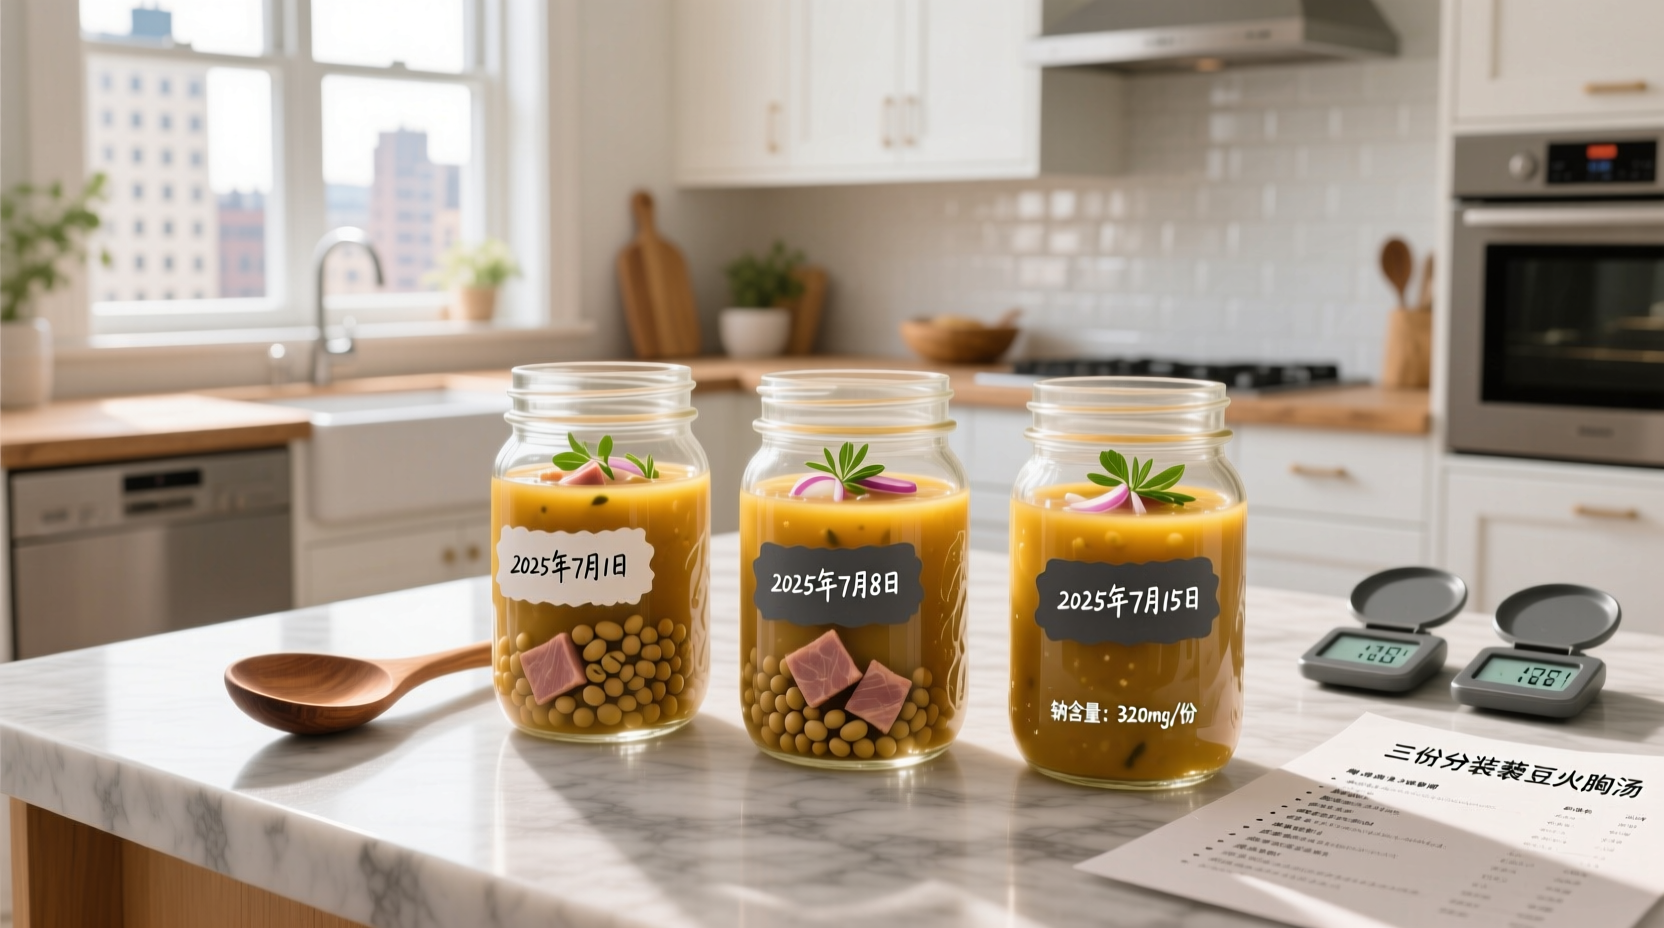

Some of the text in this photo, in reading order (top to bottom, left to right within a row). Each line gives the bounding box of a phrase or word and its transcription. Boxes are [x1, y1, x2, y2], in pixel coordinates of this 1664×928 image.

[510, 549, 627, 583] 2025年7月1日
[770, 567, 899, 603] 2025年7月8日
[1056, 583, 1199, 619] 2025年7月15日
